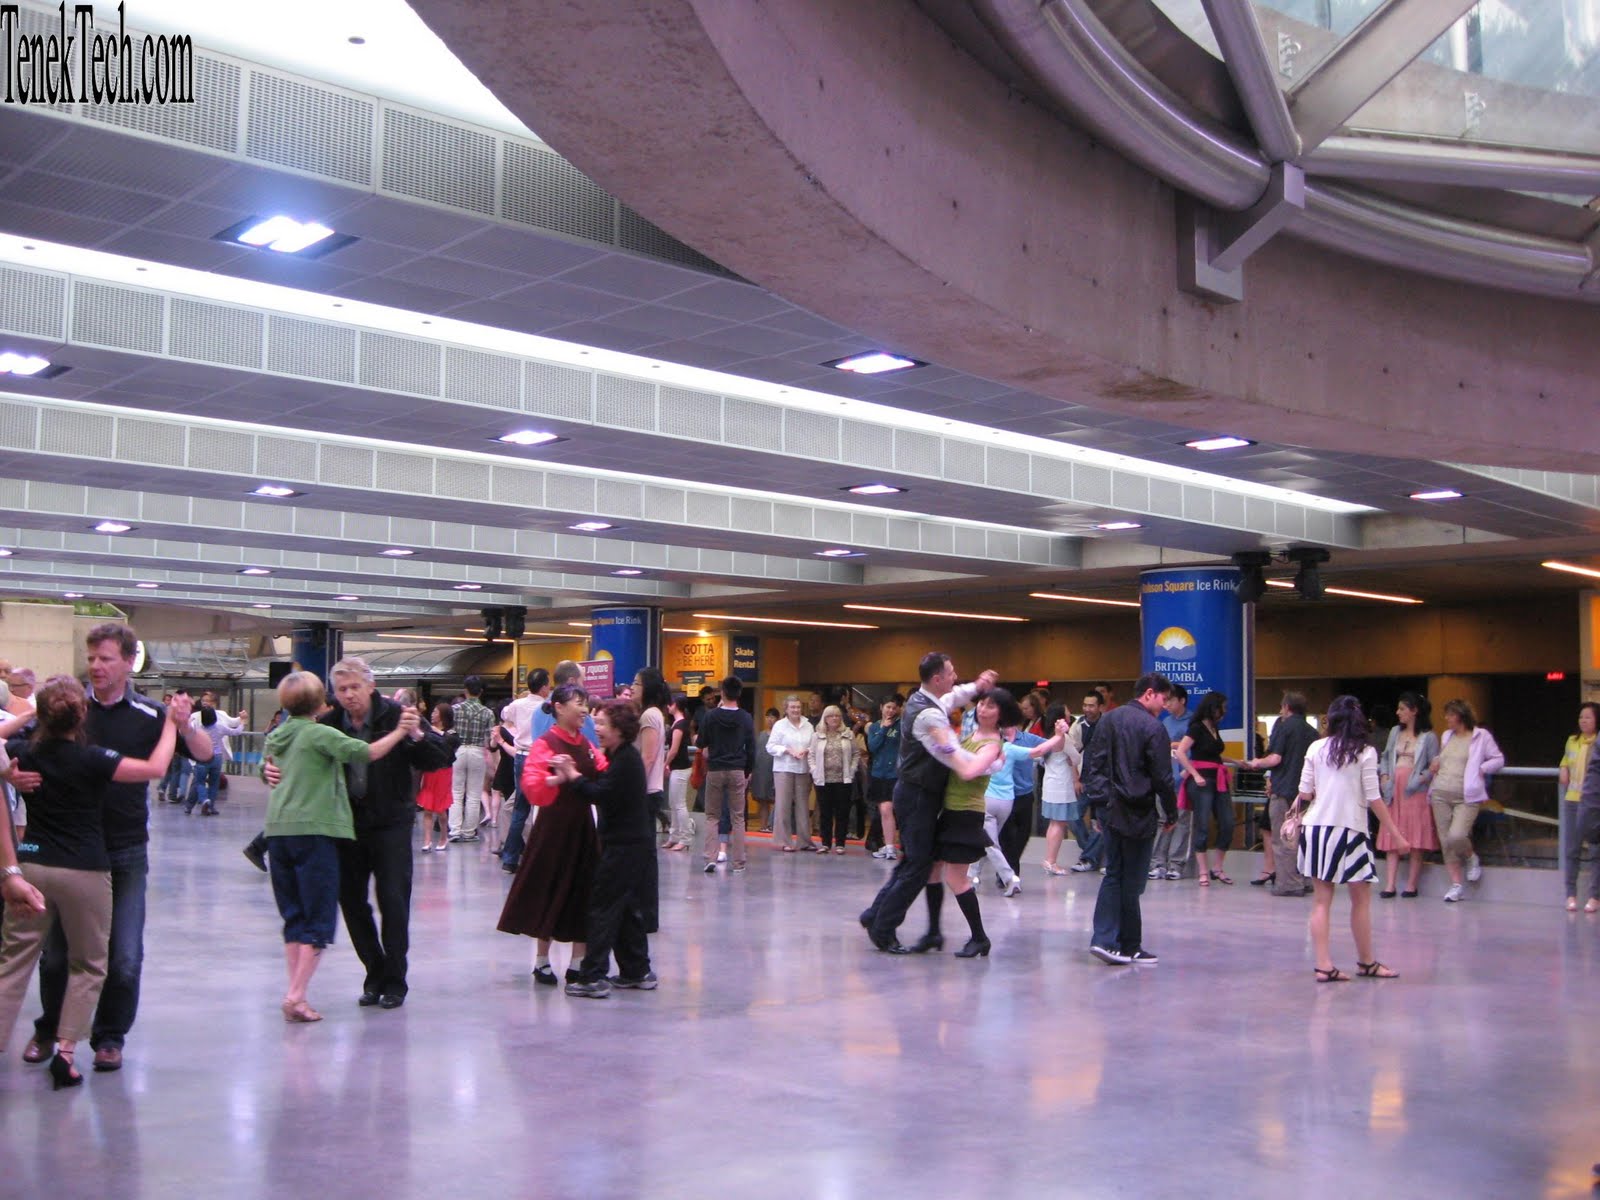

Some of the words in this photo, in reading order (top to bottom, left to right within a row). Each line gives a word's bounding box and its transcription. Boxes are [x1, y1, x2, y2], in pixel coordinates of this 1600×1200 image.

[1164, 580, 1195, 594] Square
[1196, 579, 1211, 591] Ice
[1213, 579, 1236, 591] Rink
[615, 616, 625, 625] Ice
[625, 615, 642, 625] Rink
[683, 643, 715, 655] GOTTA
[735, 647, 754, 657] Skate
[683, 655, 693, 667] BE
[694, 654, 715, 666] HERE
[733, 659, 756, 669] Rental
[1154, 661, 1197, 672] BRITISH
[1163, 672, 1204, 682] UMBIA
